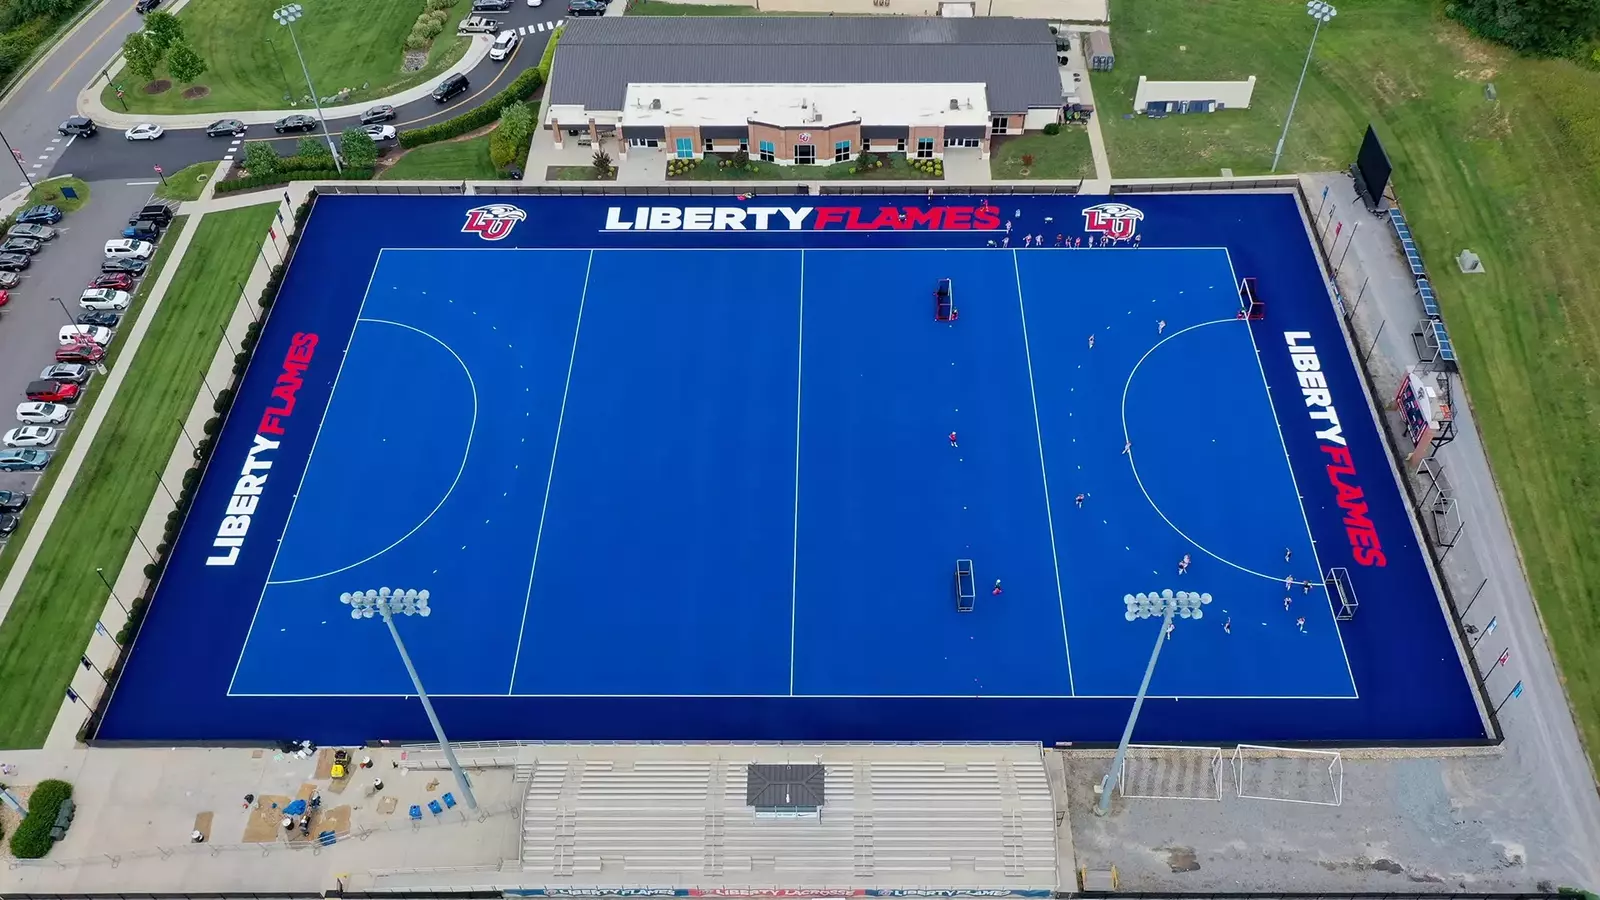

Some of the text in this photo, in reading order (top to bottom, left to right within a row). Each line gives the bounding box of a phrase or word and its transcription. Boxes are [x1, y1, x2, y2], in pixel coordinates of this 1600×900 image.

[605, 206, 1001, 230] LIBERTY FLAMES
[205, 331, 319, 566] LIBERTY FLAMES
[1283, 331, 1387, 567] LIBERTY FLAMES
